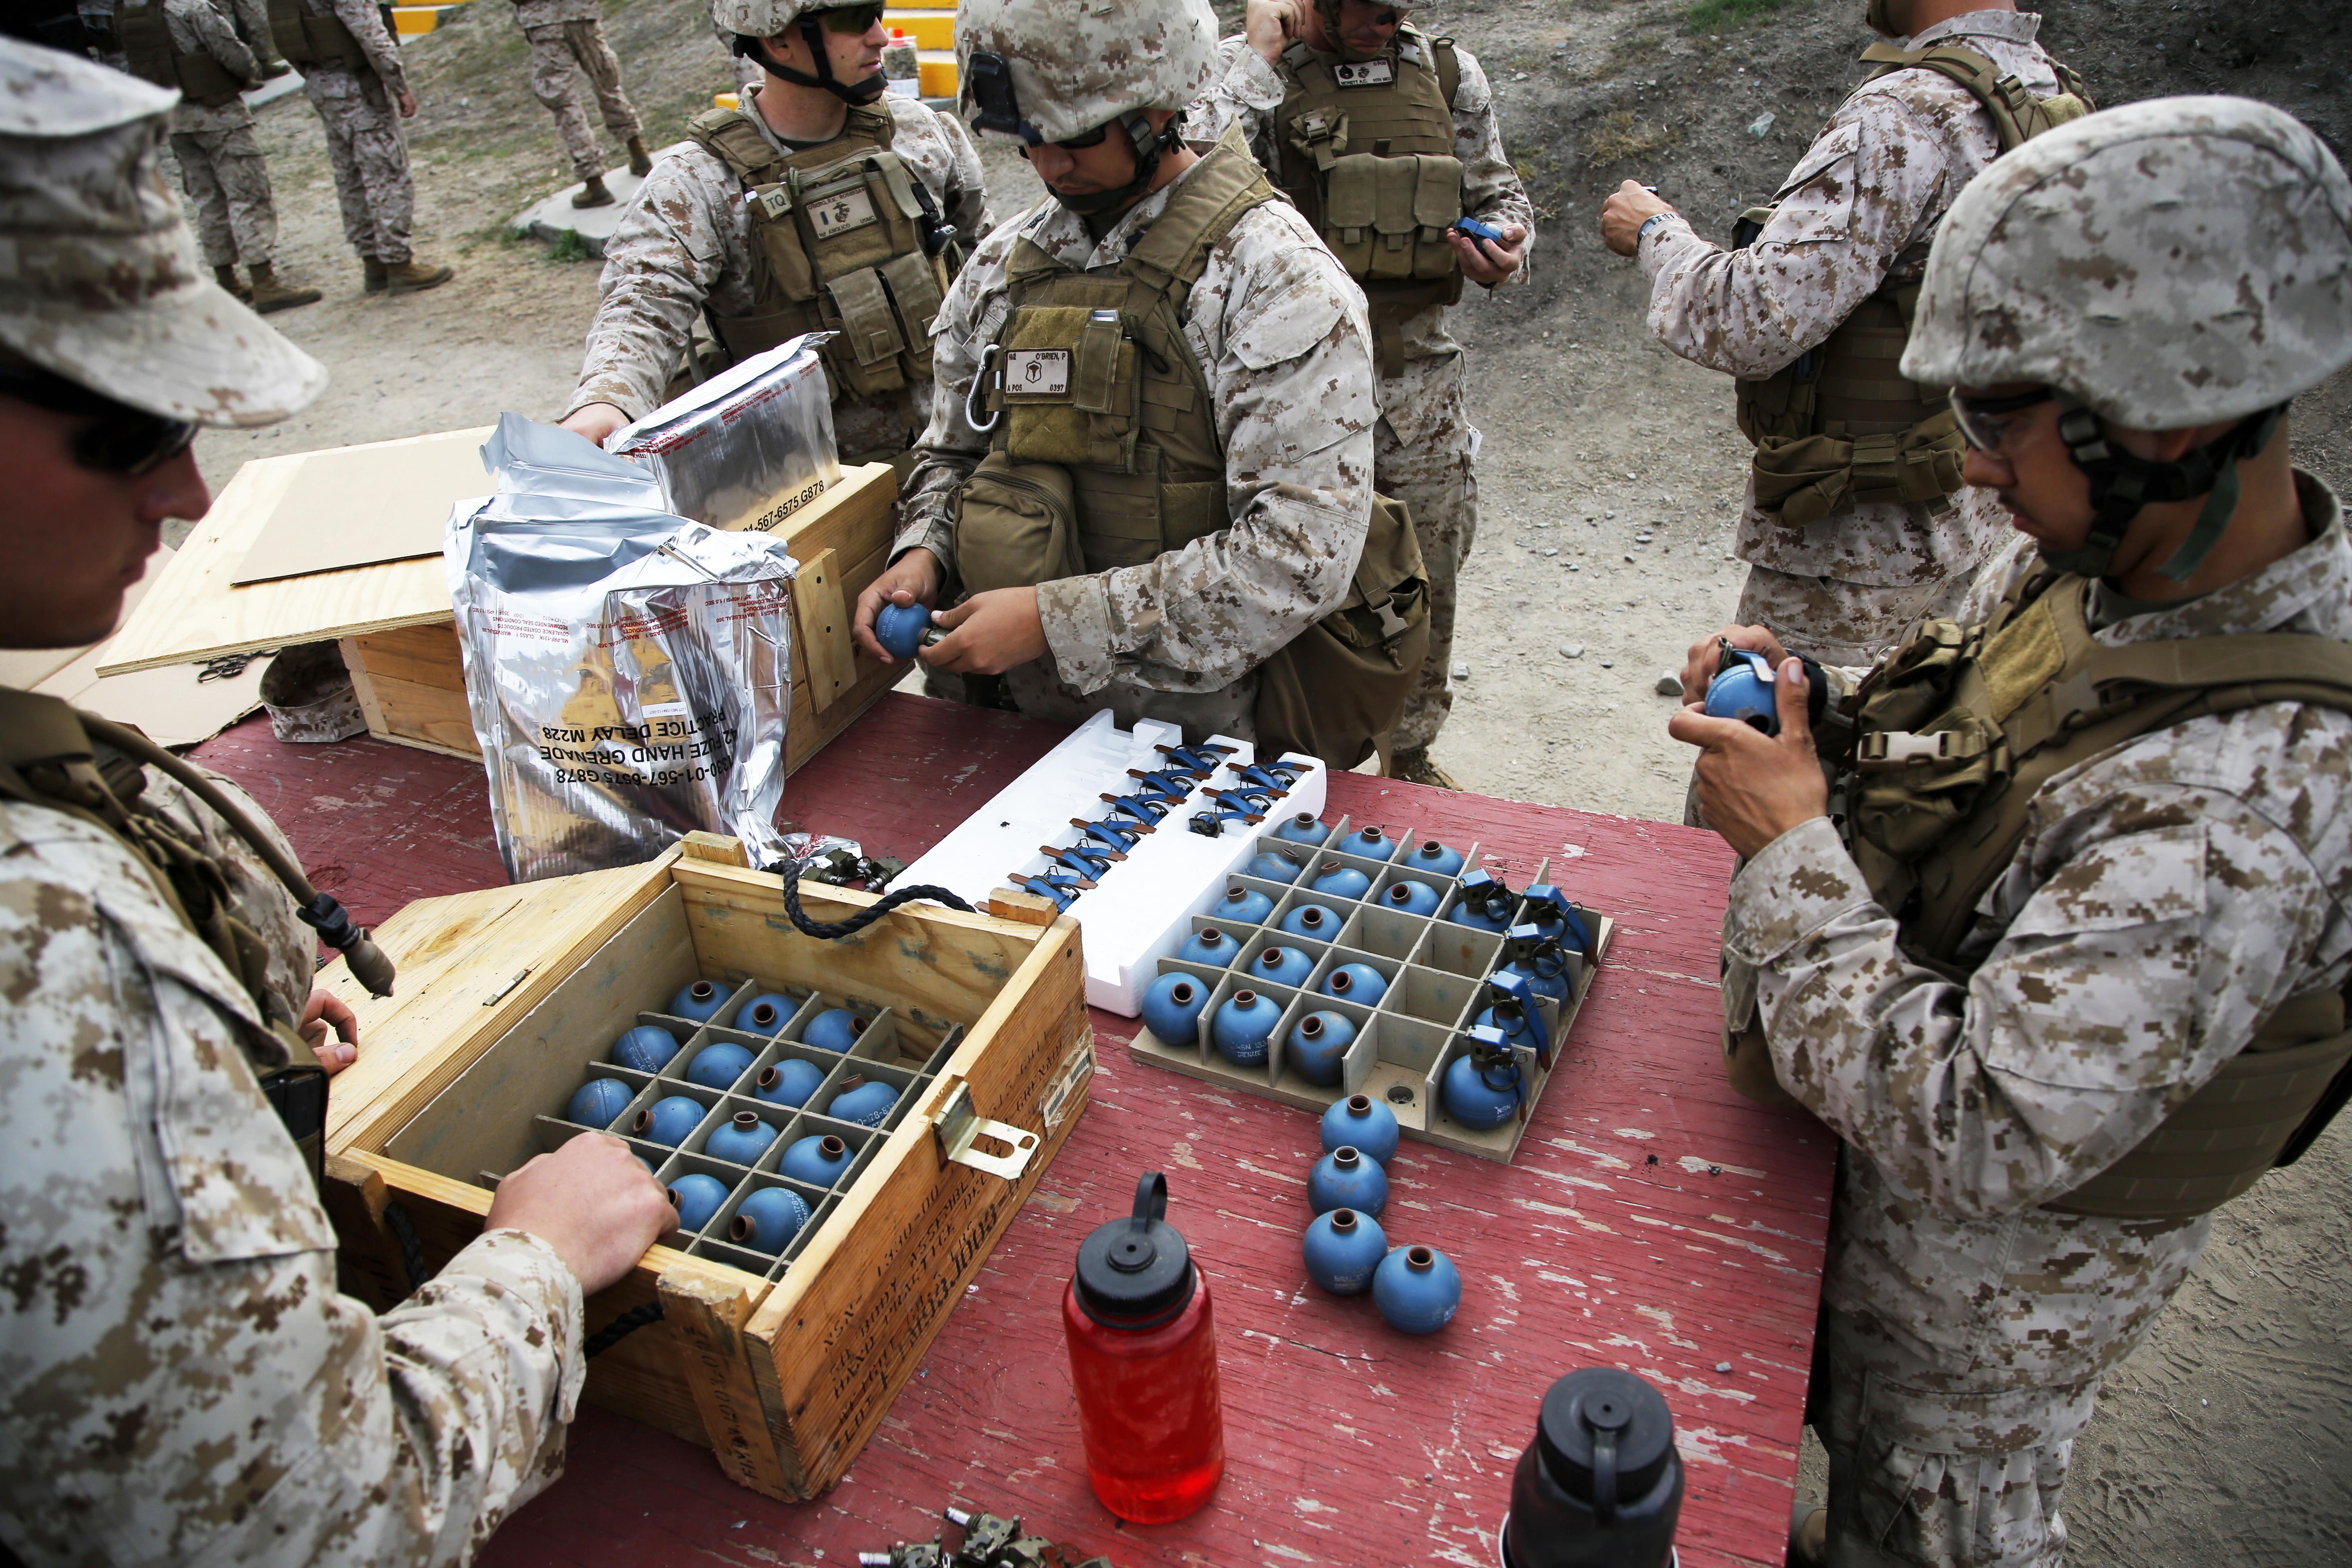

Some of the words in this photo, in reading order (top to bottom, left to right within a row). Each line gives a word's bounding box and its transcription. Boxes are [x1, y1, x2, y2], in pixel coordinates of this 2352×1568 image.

[766, 194, 786, 210] TQ
[829, 223, 850, 234] ANGLICO
[860, 216, 875, 224] USMC
[1036, 353, 1059, 361] O'BRIEN,
[722, 404, 746, 420] RECOMMENDED
[754, 389, 772, 404] CONDITIONS
[801, 481, 824, 503] G878
[535, 621, 568, 630] RECOMMENDED
[608, 634, 639, 647] MARVELSEAL
[655, 707, 726, 737] PRACTICE
[542, 727, 585, 743] M228
[591, 724, 650, 741] DELAY
[723, 728, 737, 745] 42
[539, 746, 626, 765] GRENADE
[632, 745, 684, 763] HAND
[688, 734, 722, 759] FUZE
[556, 769, 599, 783] G878
[604, 755, 733, 786] 1330-01-567-6575
[860, 1276, 898, 1339] BODY
[909, 1165, 975, 1268] ASSEMBLY
[1016, 1038, 1062, 1112] GRENADE
[833, 1333, 875, 1401] HAND
[884, 1217, 954, 1326] PRACTICE
[963, 1146, 1002, 1211] DELY
[823, 1290, 863, 1353] NSN-
[839, 1335, 895, 1427] WEIGHT
[950, 1218, 973, 1263] LBS
[844, 1394, 872, 1445] LOT
